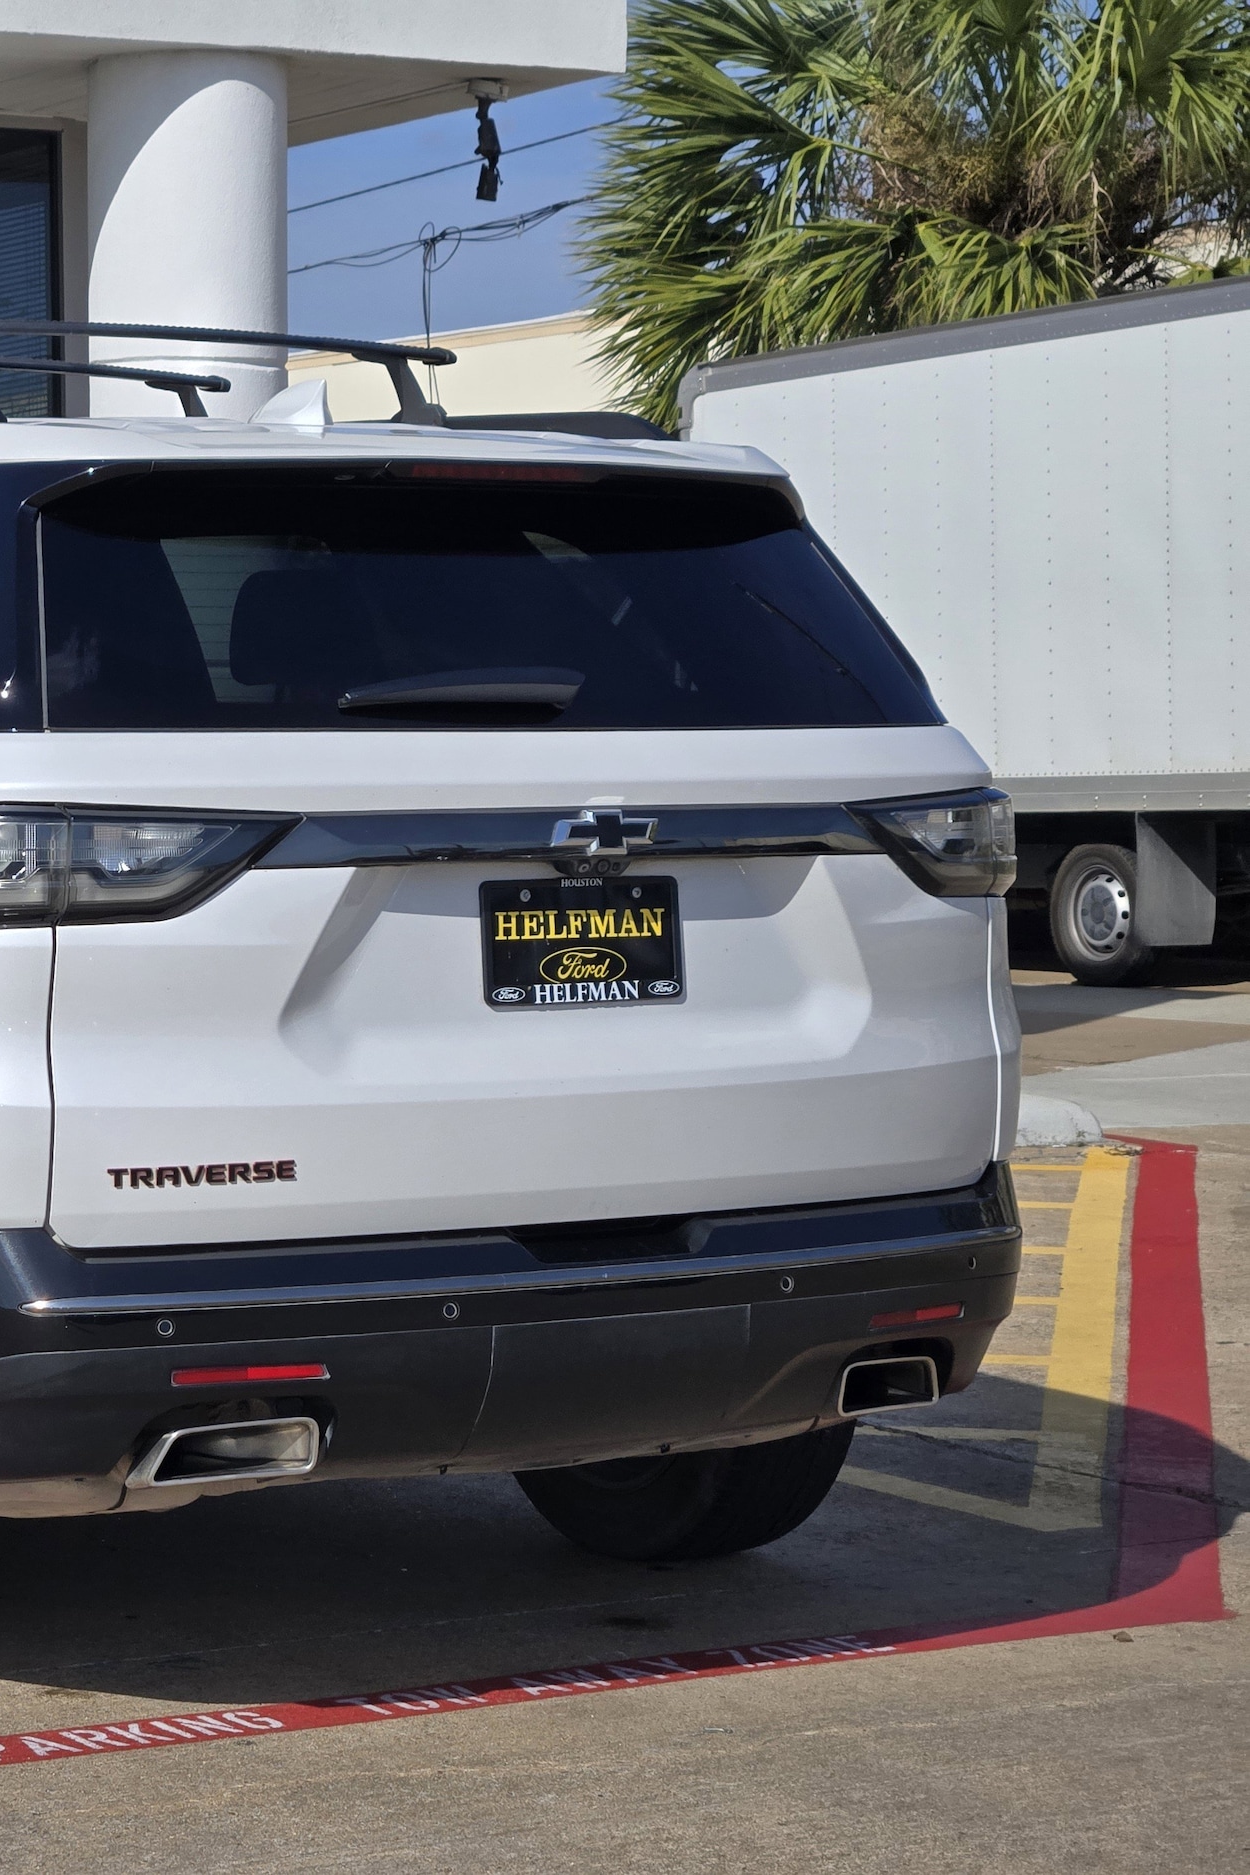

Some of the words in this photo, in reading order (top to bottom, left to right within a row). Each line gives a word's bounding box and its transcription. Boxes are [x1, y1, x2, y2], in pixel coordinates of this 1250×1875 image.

[560, 877, 603, 888] HOUSTON
[494, 908, 665, 941] HELFMAN
[557, 951, 610, 980] Ford
[533, 980, 640, 1005] HELFMAN
[107, 1159, 298, 1190] TRAVERSE
[335, 1685, 489, 1716] TOW
[510, 1656, 699, 1696] AWAY
